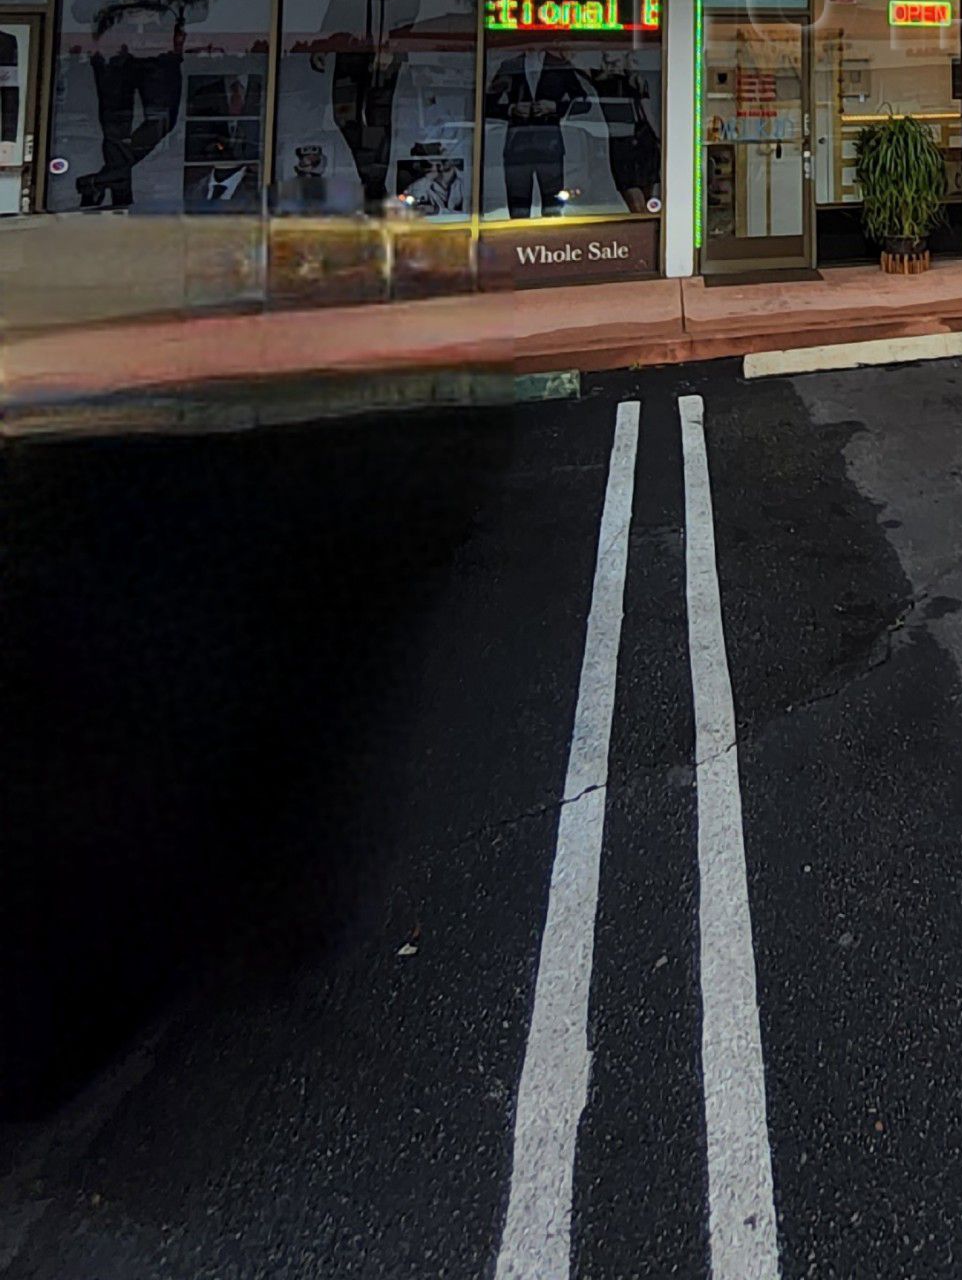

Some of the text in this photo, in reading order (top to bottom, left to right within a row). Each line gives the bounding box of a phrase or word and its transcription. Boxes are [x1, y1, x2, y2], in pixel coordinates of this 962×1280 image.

[894, 4, 948, 23] OPEN
[516, 241, 628, 265] Whole Sale
